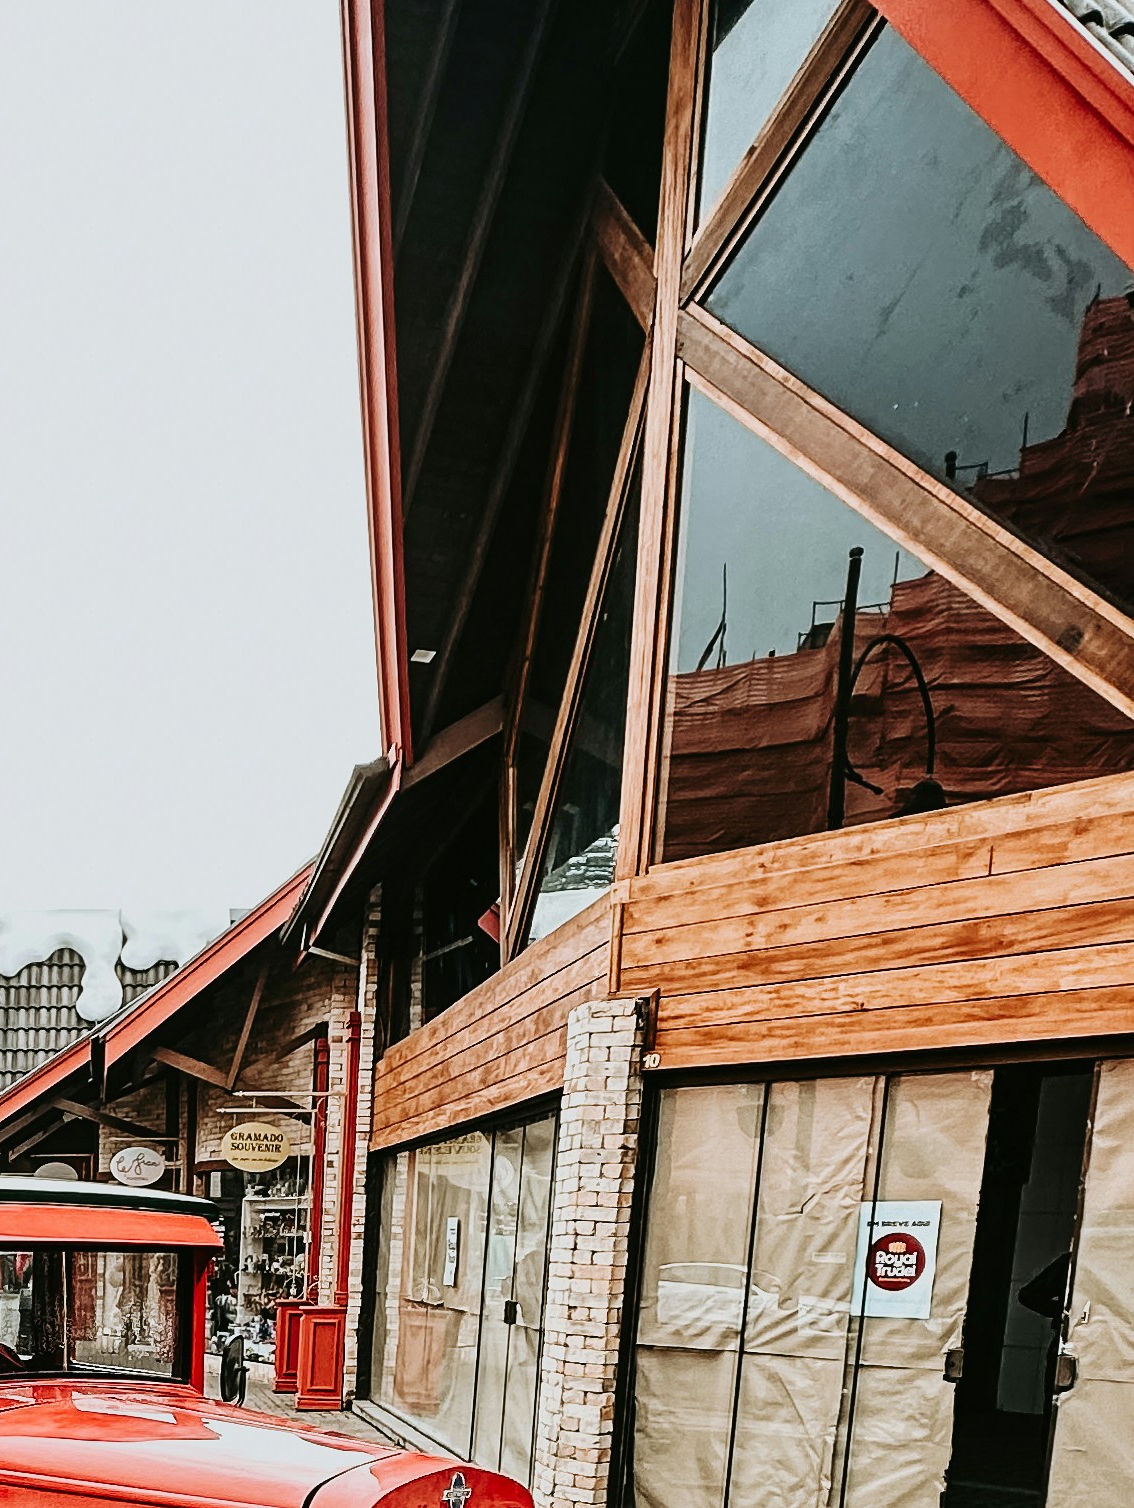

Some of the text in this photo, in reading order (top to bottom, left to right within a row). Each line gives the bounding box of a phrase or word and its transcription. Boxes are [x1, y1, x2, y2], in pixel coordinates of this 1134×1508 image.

[643, 1053, 660, 1069] 10
[230, 1132, 284, 1143] GRAMADO
[230, 1143, 282, 1153] SOUVENIR
[876, 1251, 918, 1267] Royal
